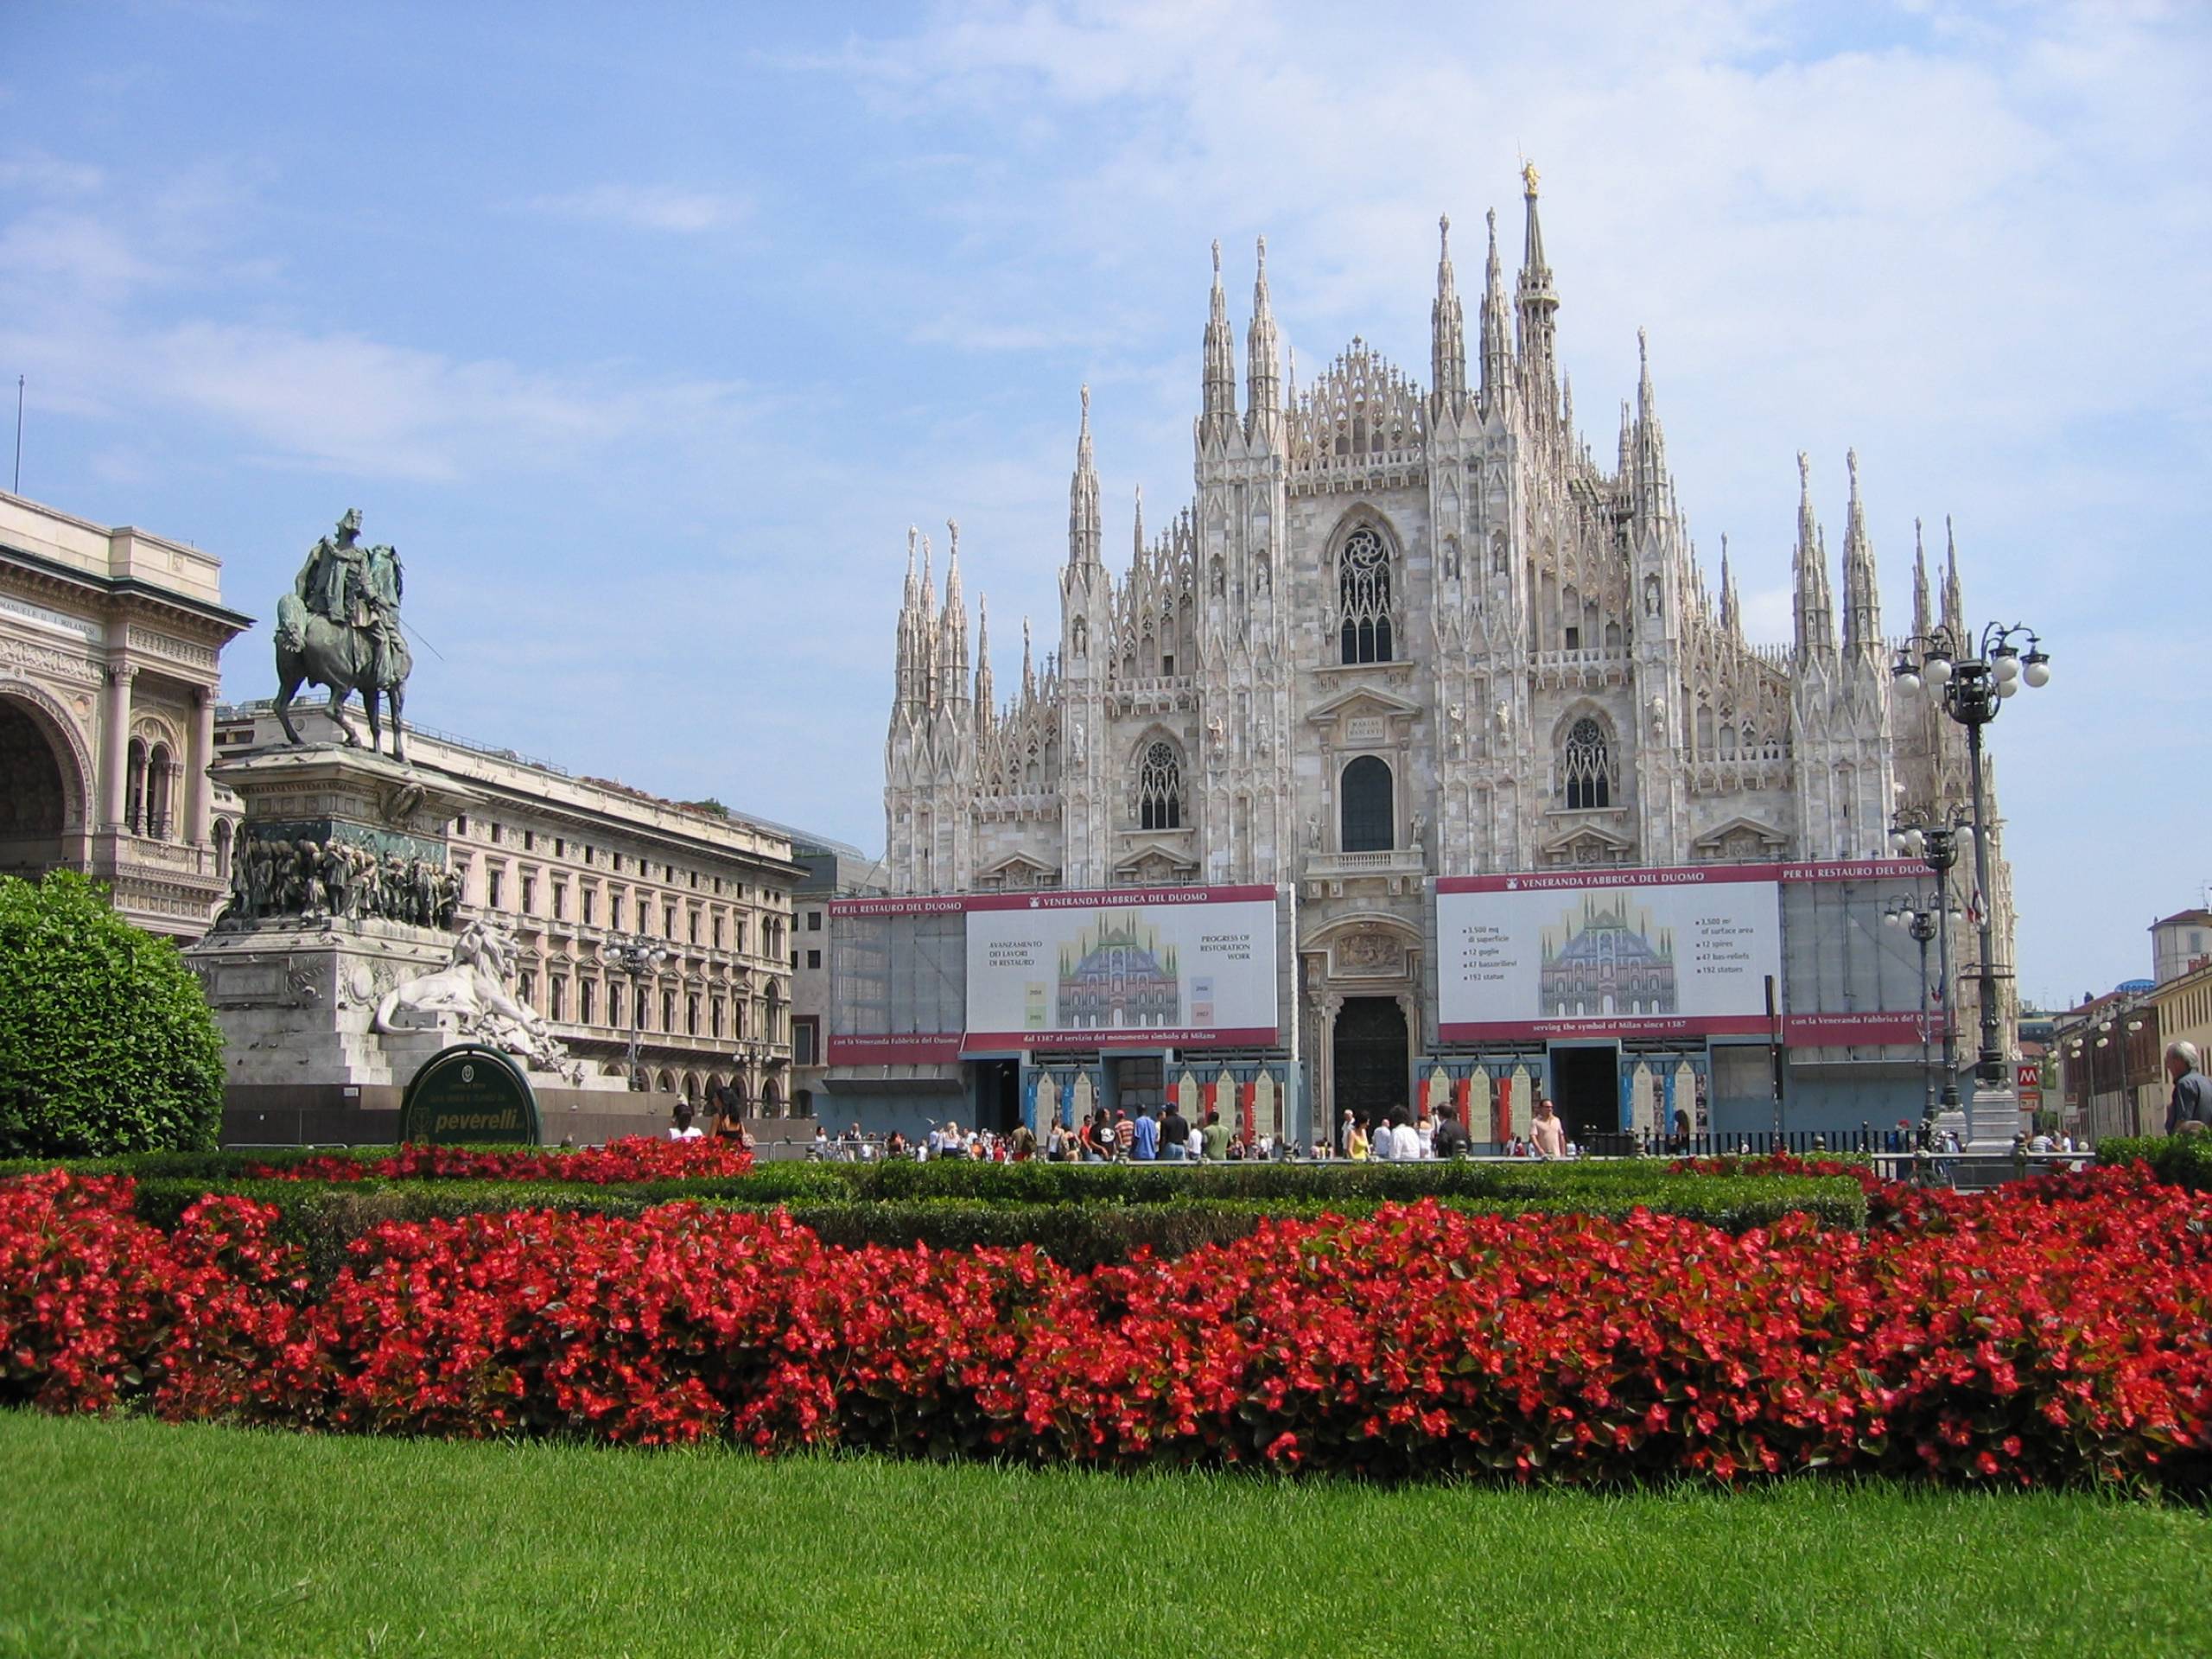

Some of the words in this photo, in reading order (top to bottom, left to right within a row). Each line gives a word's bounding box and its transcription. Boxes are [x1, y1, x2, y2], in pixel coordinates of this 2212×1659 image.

[1783, 869, 1802, 879] PER
[1805, 869, 1814, 878] IL
[1818, 867, 1872, 877] RESTAURO
[1876, 866, 1895, 874] DEL
[1898, 865, 1937, 874] DUOM
[1522, 877, 1584, 887] VENERANDA
[1586, 874, 1636, 885] FABBRICA
[1639, 874, 1658, 882] DEL
[1662, 873, 1705, 882] DUOMO
[1044, 897, 1098, 906] VENERANDA
[1102, 895, 1145, 905] FABBRICA
[1148, 893, 1166, 902] DEL
[1168, 893, 1207, 901] DUOMO
[861, 904, 904, 913] RESTAURO
[907, 903, 923, 912] DEL
[925, 902, 962, 911] DUOMO
[1533, 1022, 1561, 1032] serving
[1578, 1021, 1606, 1032] symbol
[1619, 1020, 1642, 1029] Milan
[1808, 1016, 1815, 1025] la
[1818, 1016, 1861, 1025] Veneranda
[1863, 1014, 1898, 1024] Fabbrica
[1901, 1014, 1914, 1022] del
[1151, 1032, 1179, 1040] simbolo
[2019, 1069, 2037, 1083] M
[435, 1109, 518, 1134] peverelli
